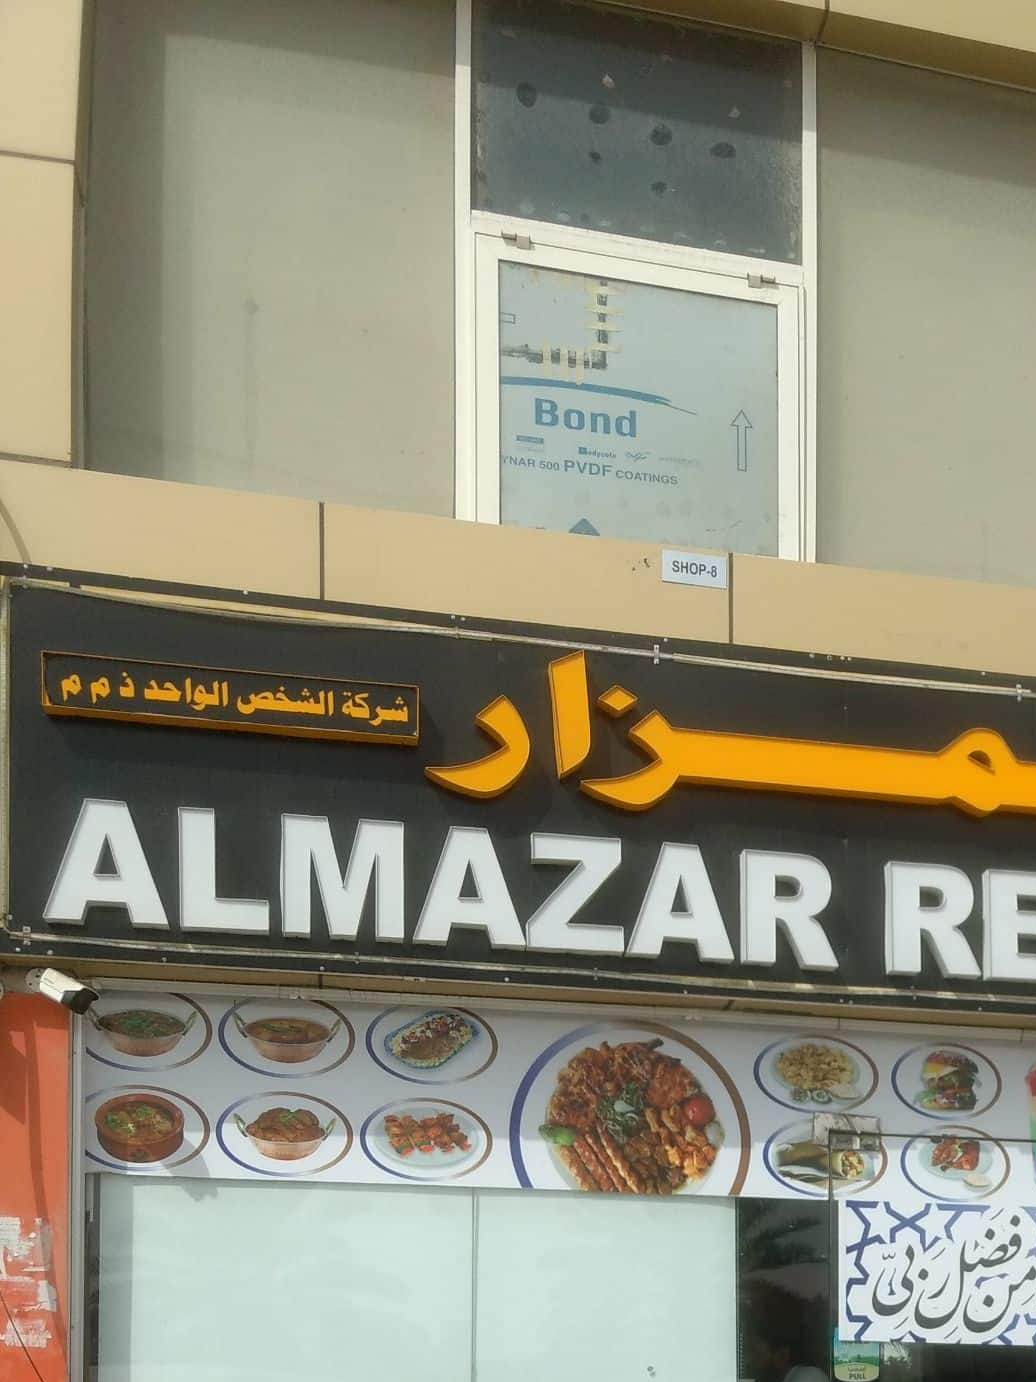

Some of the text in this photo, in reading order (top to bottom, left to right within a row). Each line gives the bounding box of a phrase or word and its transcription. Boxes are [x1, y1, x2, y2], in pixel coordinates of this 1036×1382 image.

[534, 398, 638, 438] Bond
[539, 460, 560, 472] 500
[563, 459, 614, 477] PVDF
[615, 469, 679, 486] COATINGS
[671, 559, 718, 579] SHOP-8
[60, 671, 409, 727] شركة الشخص الواحد ذ م م
[42, 797, 840, 973] ALMAZAR
